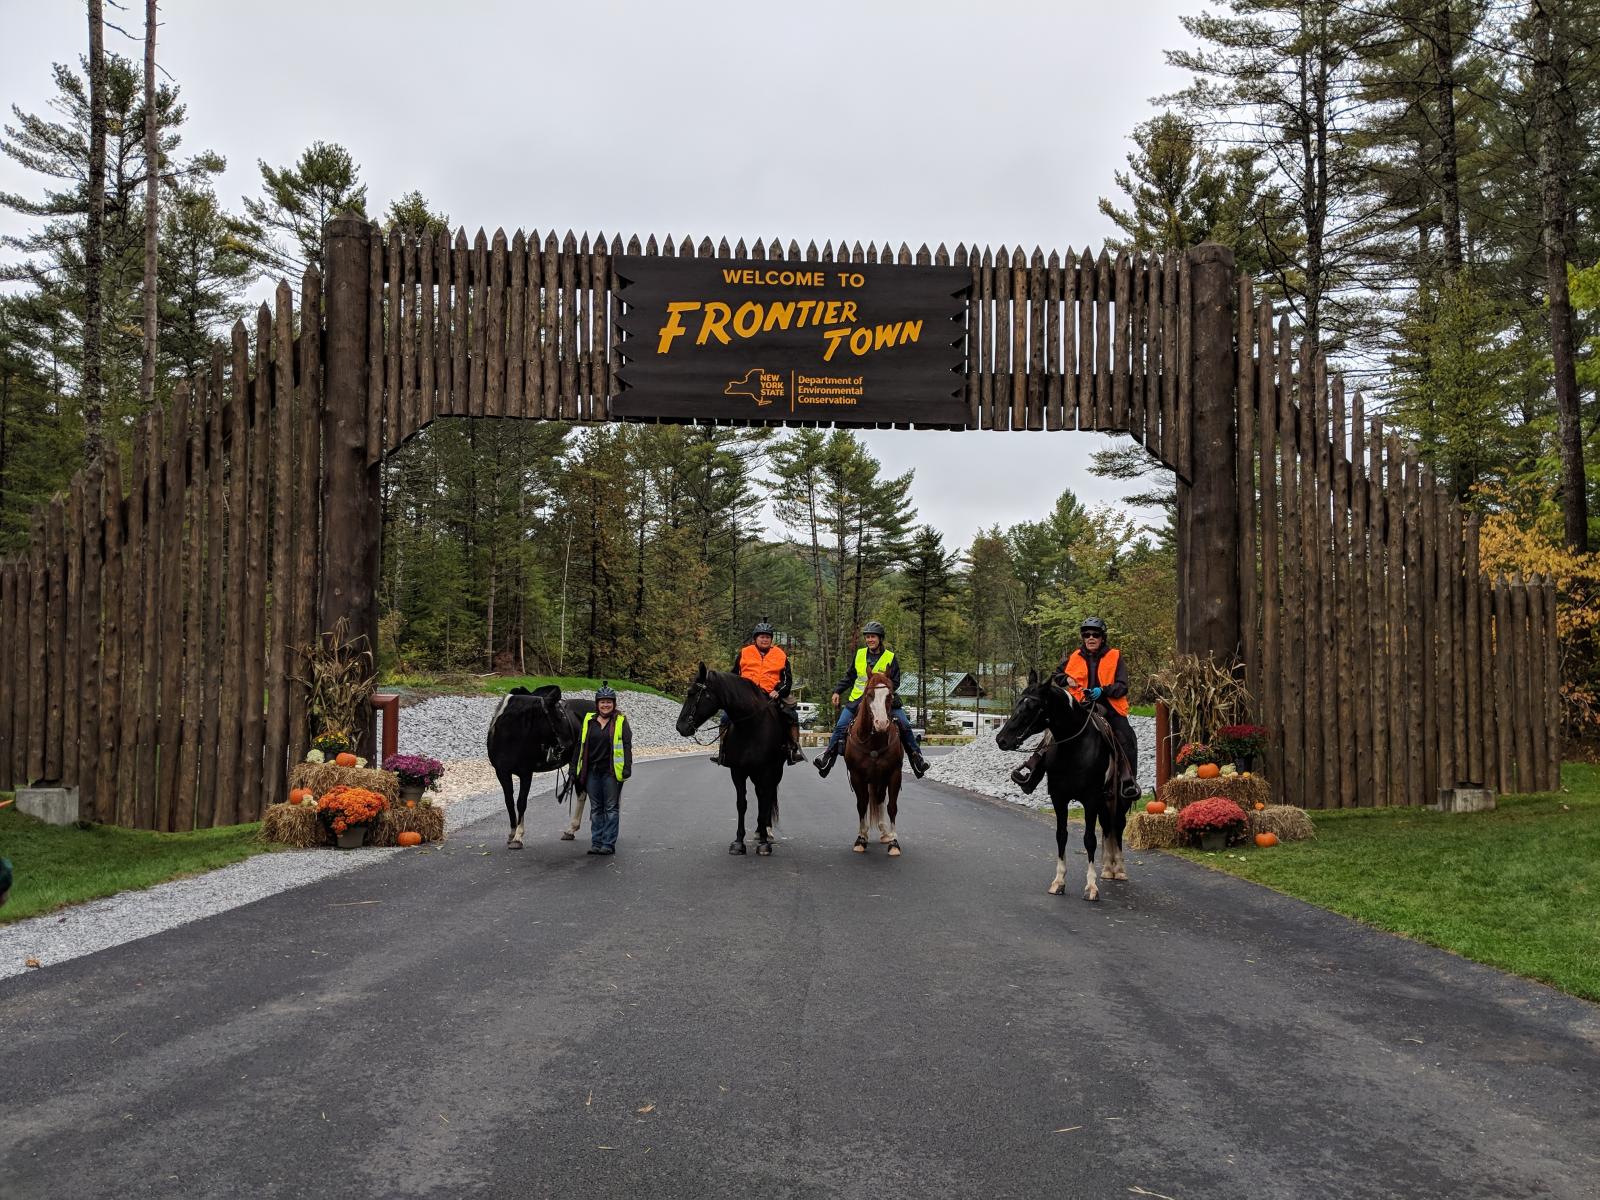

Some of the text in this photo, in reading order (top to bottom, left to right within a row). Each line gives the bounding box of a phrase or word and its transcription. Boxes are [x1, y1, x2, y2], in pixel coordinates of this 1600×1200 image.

[722, 269, 865, 288] WELCOME TO
[656, 300, 858, 354] FRONTIER
[823, 319, 924, 362] TOWN
[760, 374, 780, 382] NEW
[798, 375, 864, 386] Department of
[798, 386, 863, 395] Environmental
[798, 395, 857, 405] Conservation
